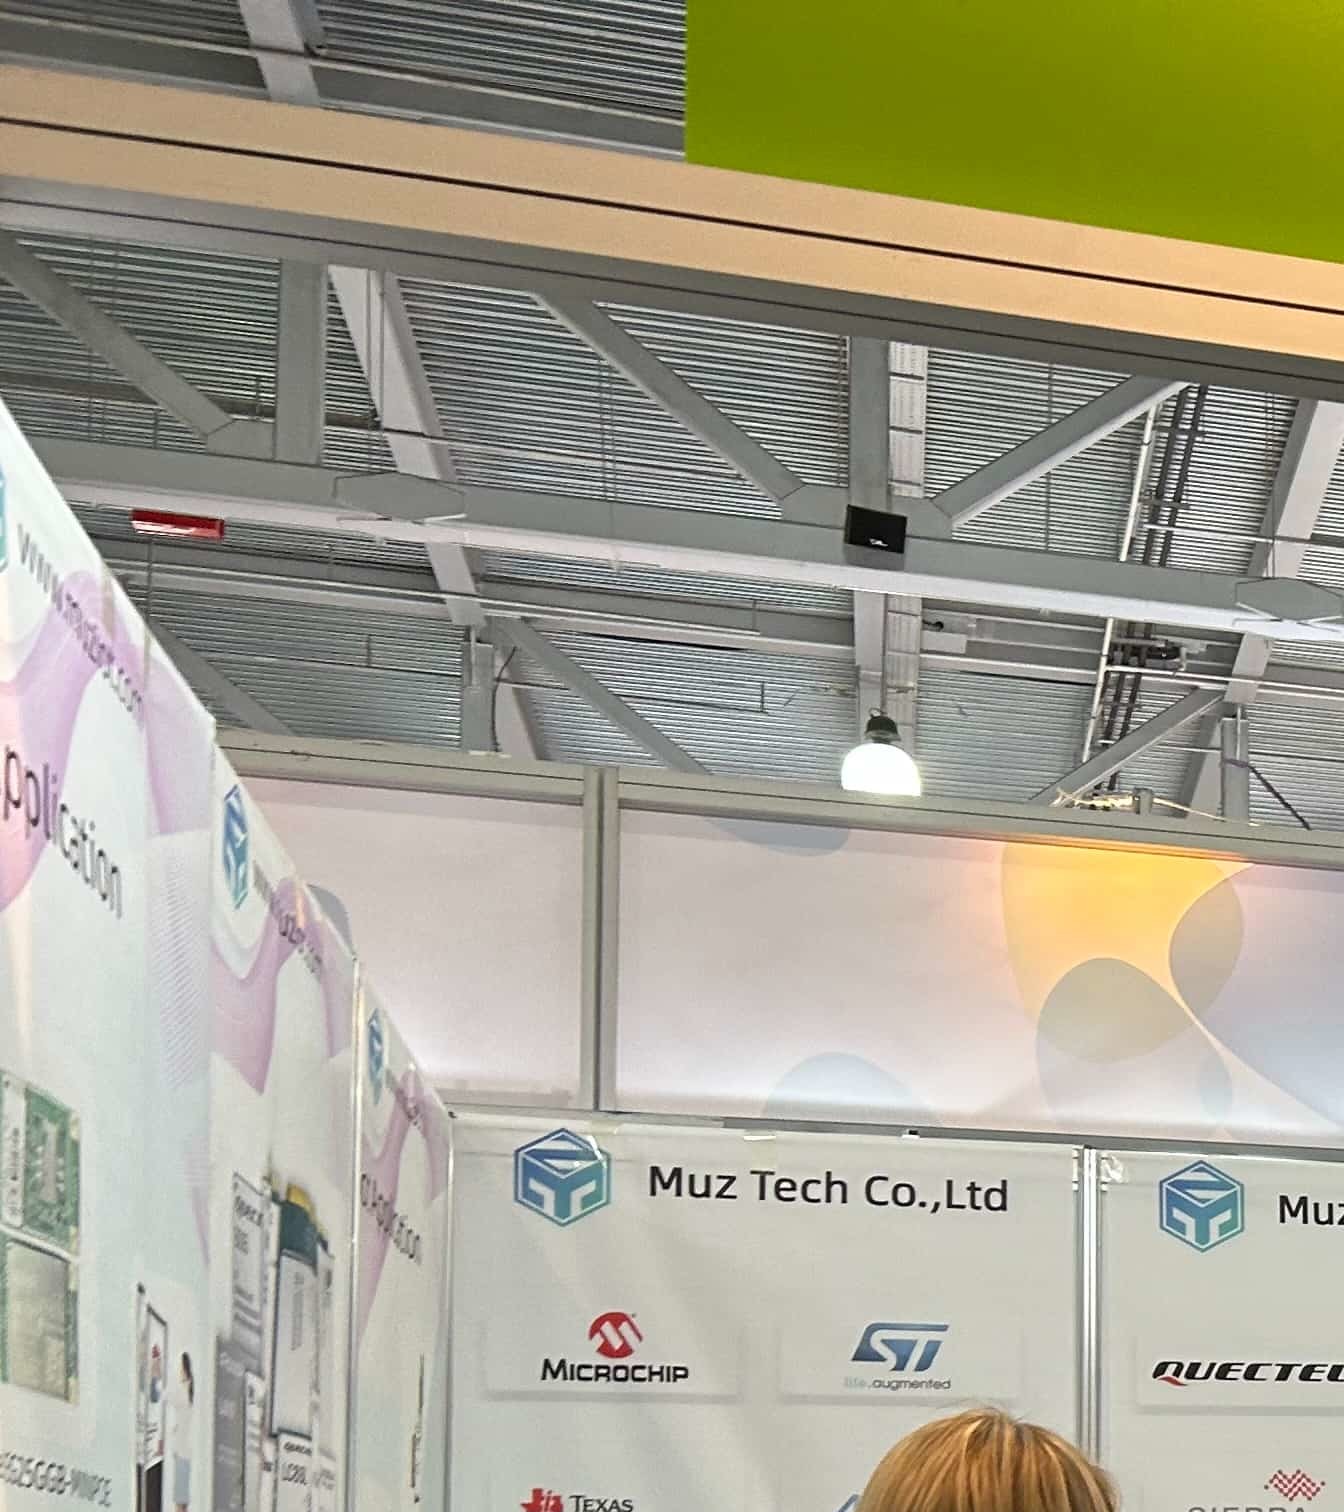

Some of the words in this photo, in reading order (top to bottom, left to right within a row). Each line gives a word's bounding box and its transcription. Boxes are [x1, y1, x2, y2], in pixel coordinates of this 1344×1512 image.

[0, 742, 123, 920] pplication
[648, 1165, 738, 1201] Muz
[752, 1170, 848, 1205] Tech
[864, 1175, 1008, 1214] Co.,Ltd
[850, 1321, 949, 1372] ST
